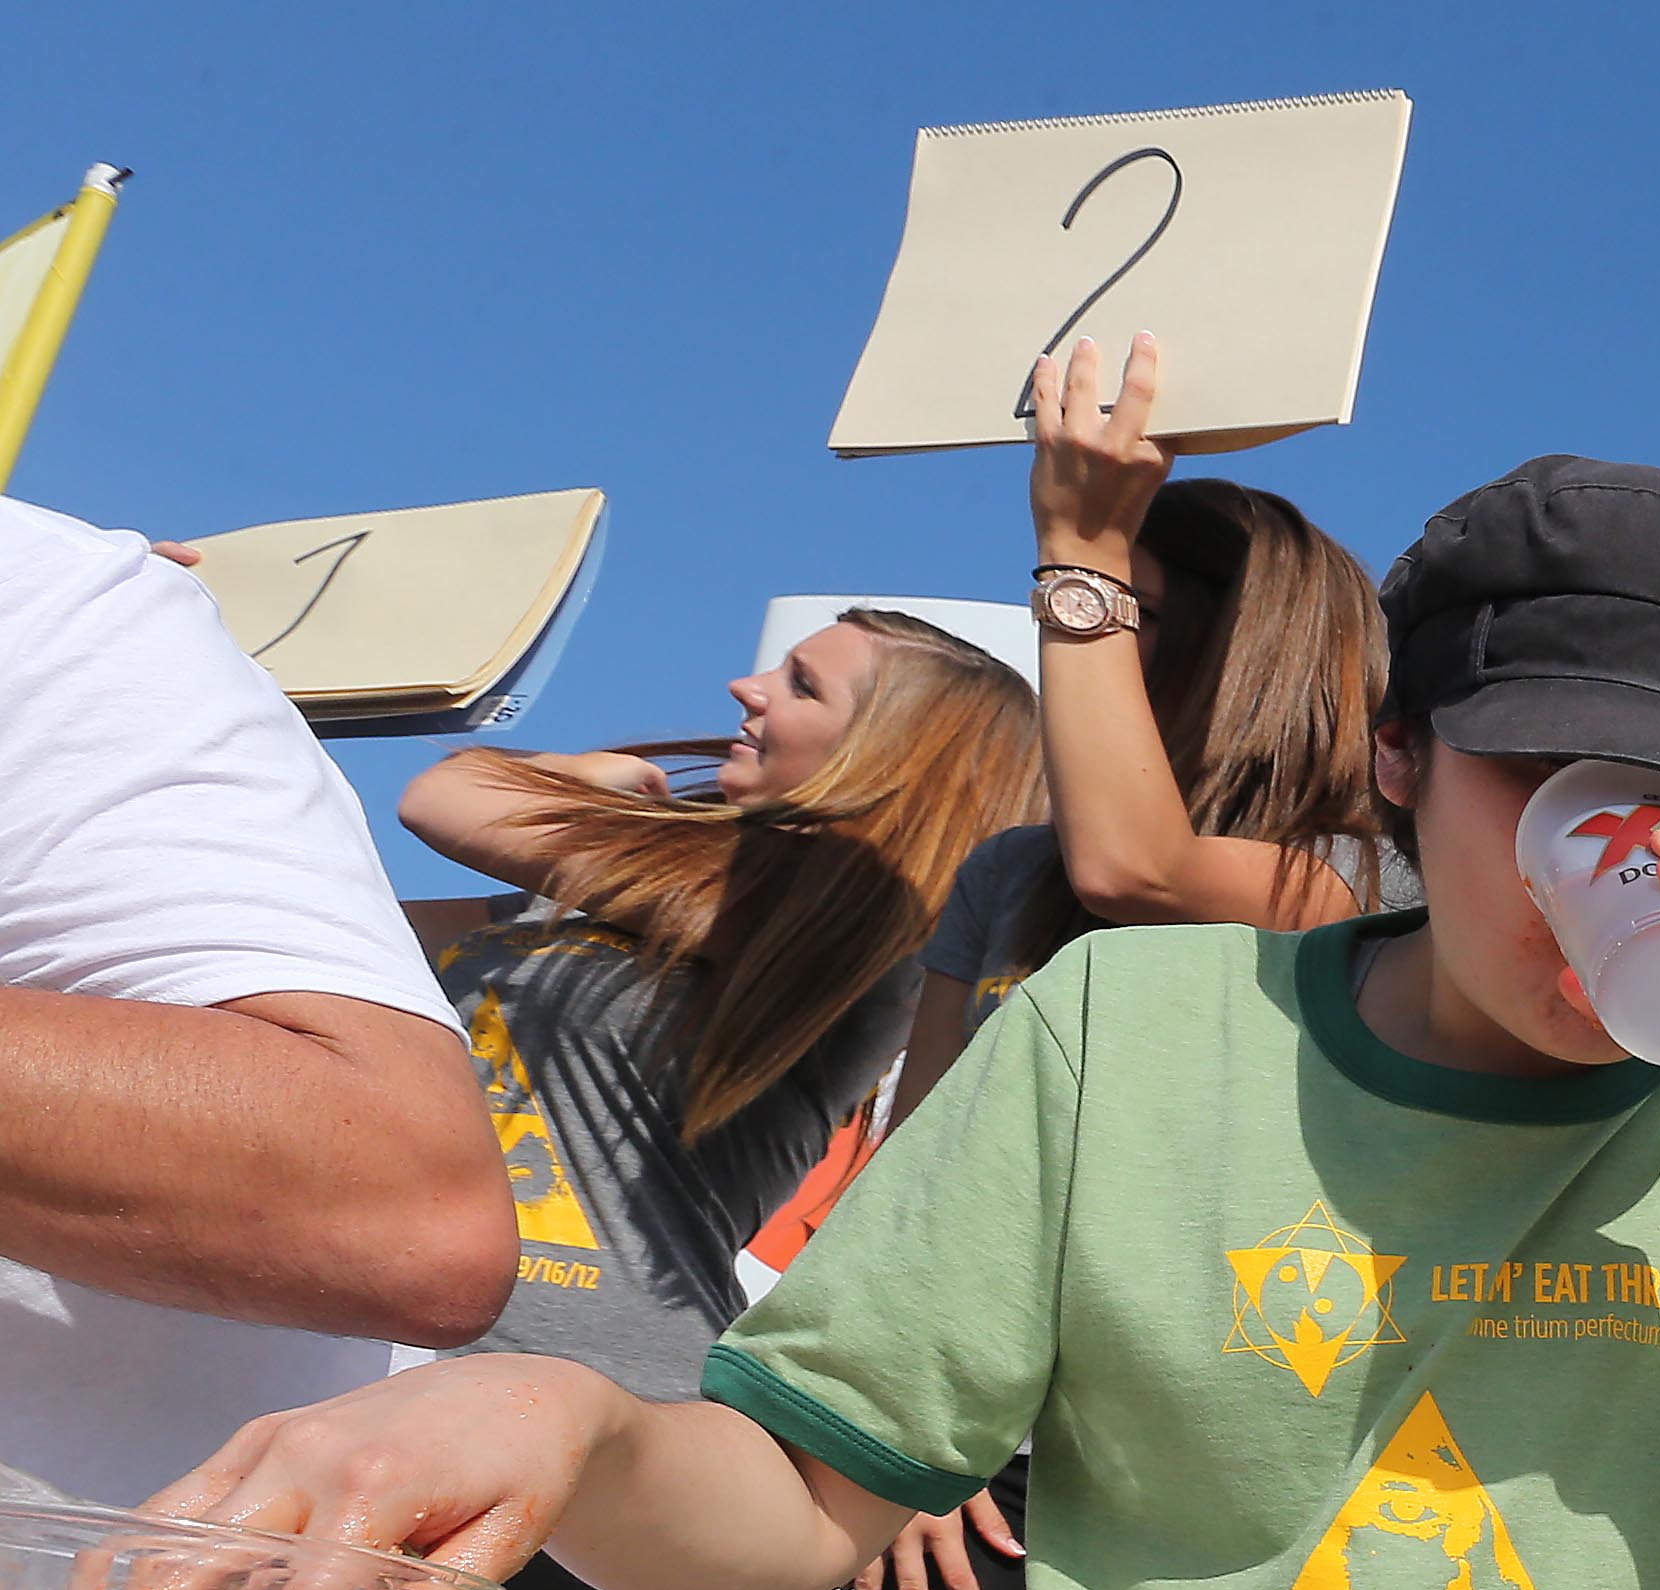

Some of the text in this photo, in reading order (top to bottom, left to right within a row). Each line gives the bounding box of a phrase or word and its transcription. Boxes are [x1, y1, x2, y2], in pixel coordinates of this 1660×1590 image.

[1014, 147, 1183, 418] 2
[1534, 1262, 1593, 1304] EAT
[1514, 1313, 1568, 1339] trium
